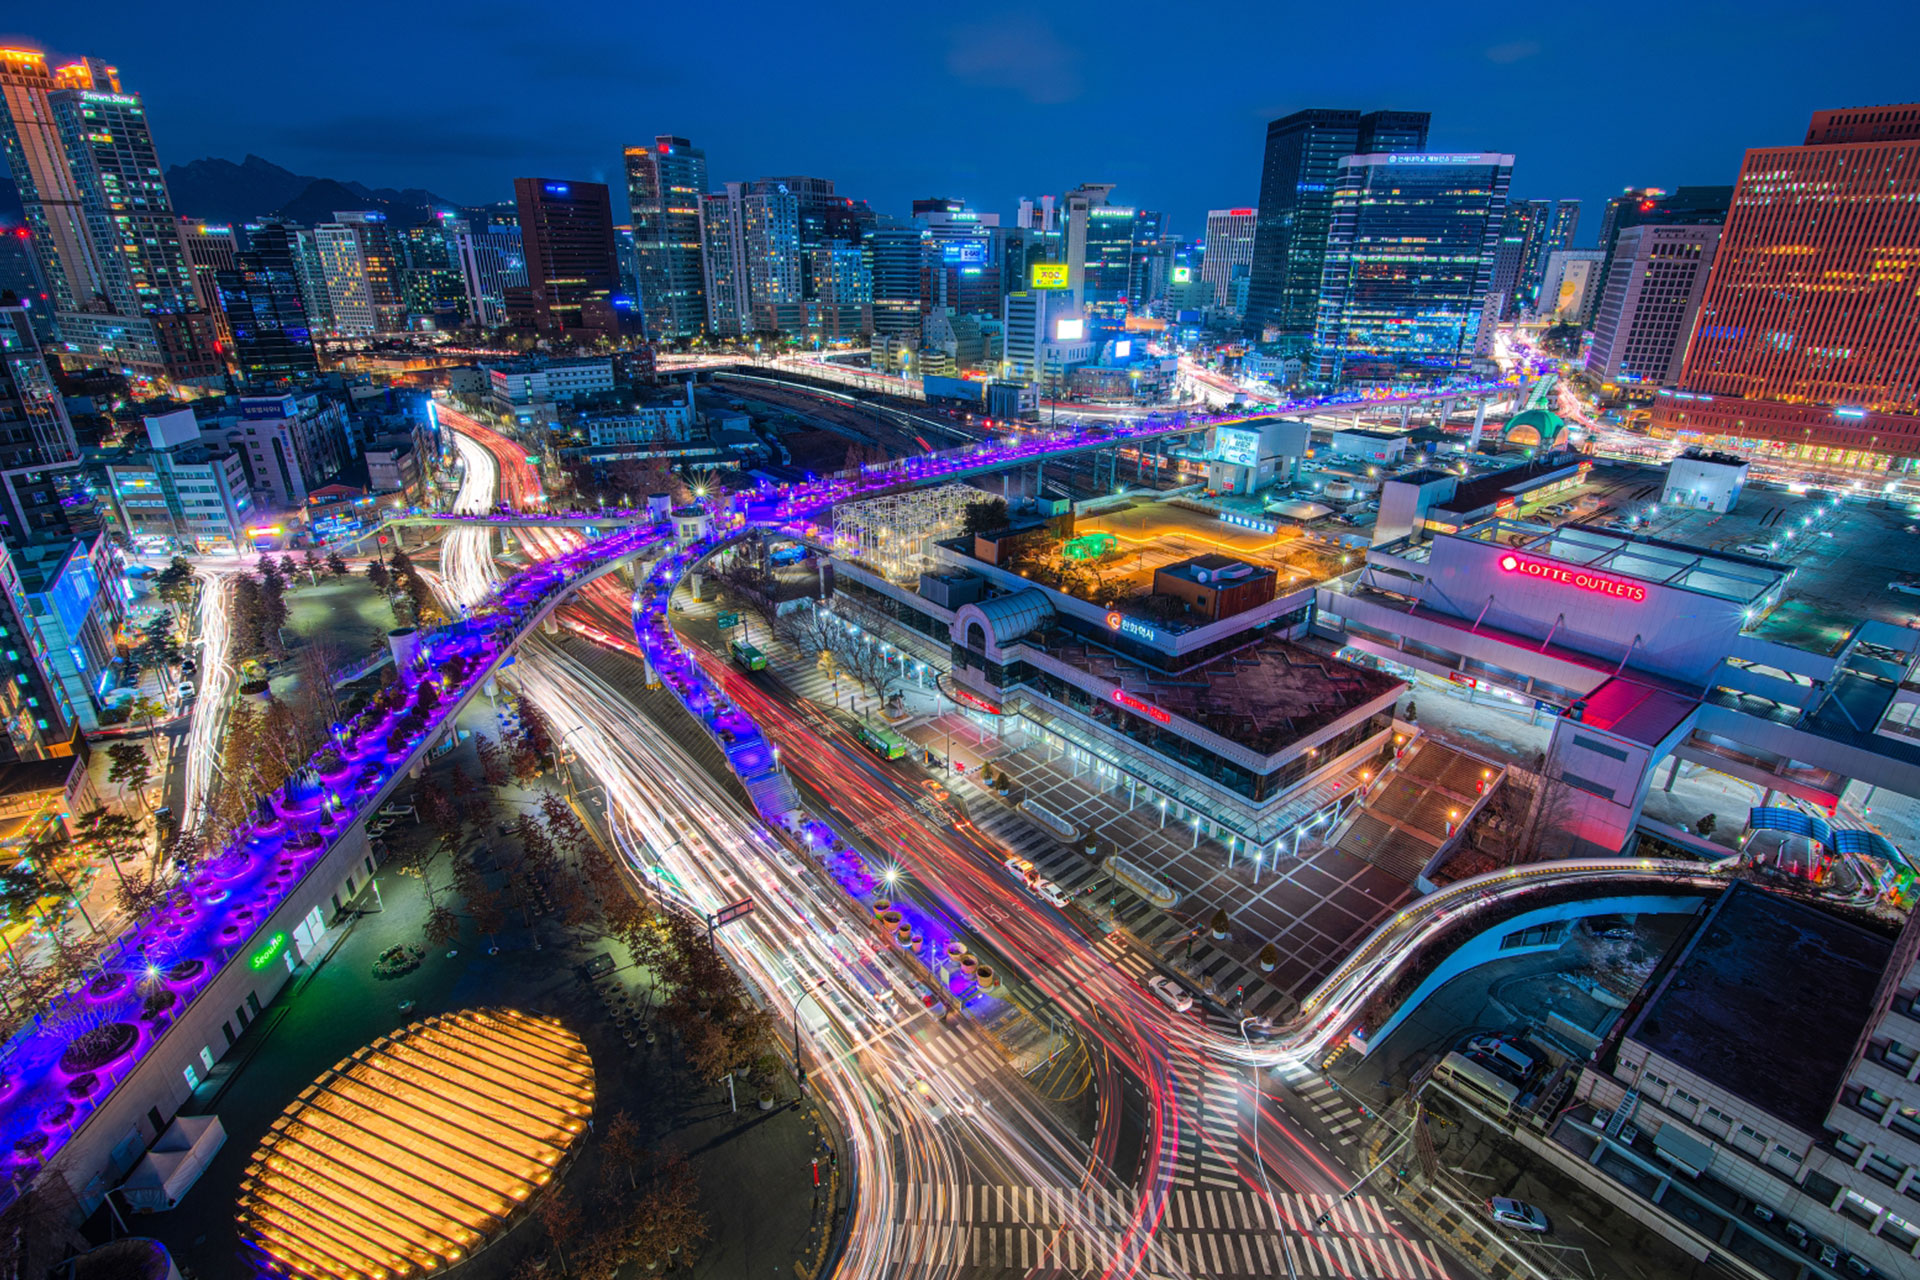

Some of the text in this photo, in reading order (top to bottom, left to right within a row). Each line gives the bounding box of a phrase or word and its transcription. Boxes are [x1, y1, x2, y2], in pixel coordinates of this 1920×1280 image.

[1519, 561, 1644, 601] LOTTE OUTLETS
[1121, 619, 1154, 641] 한화역사
